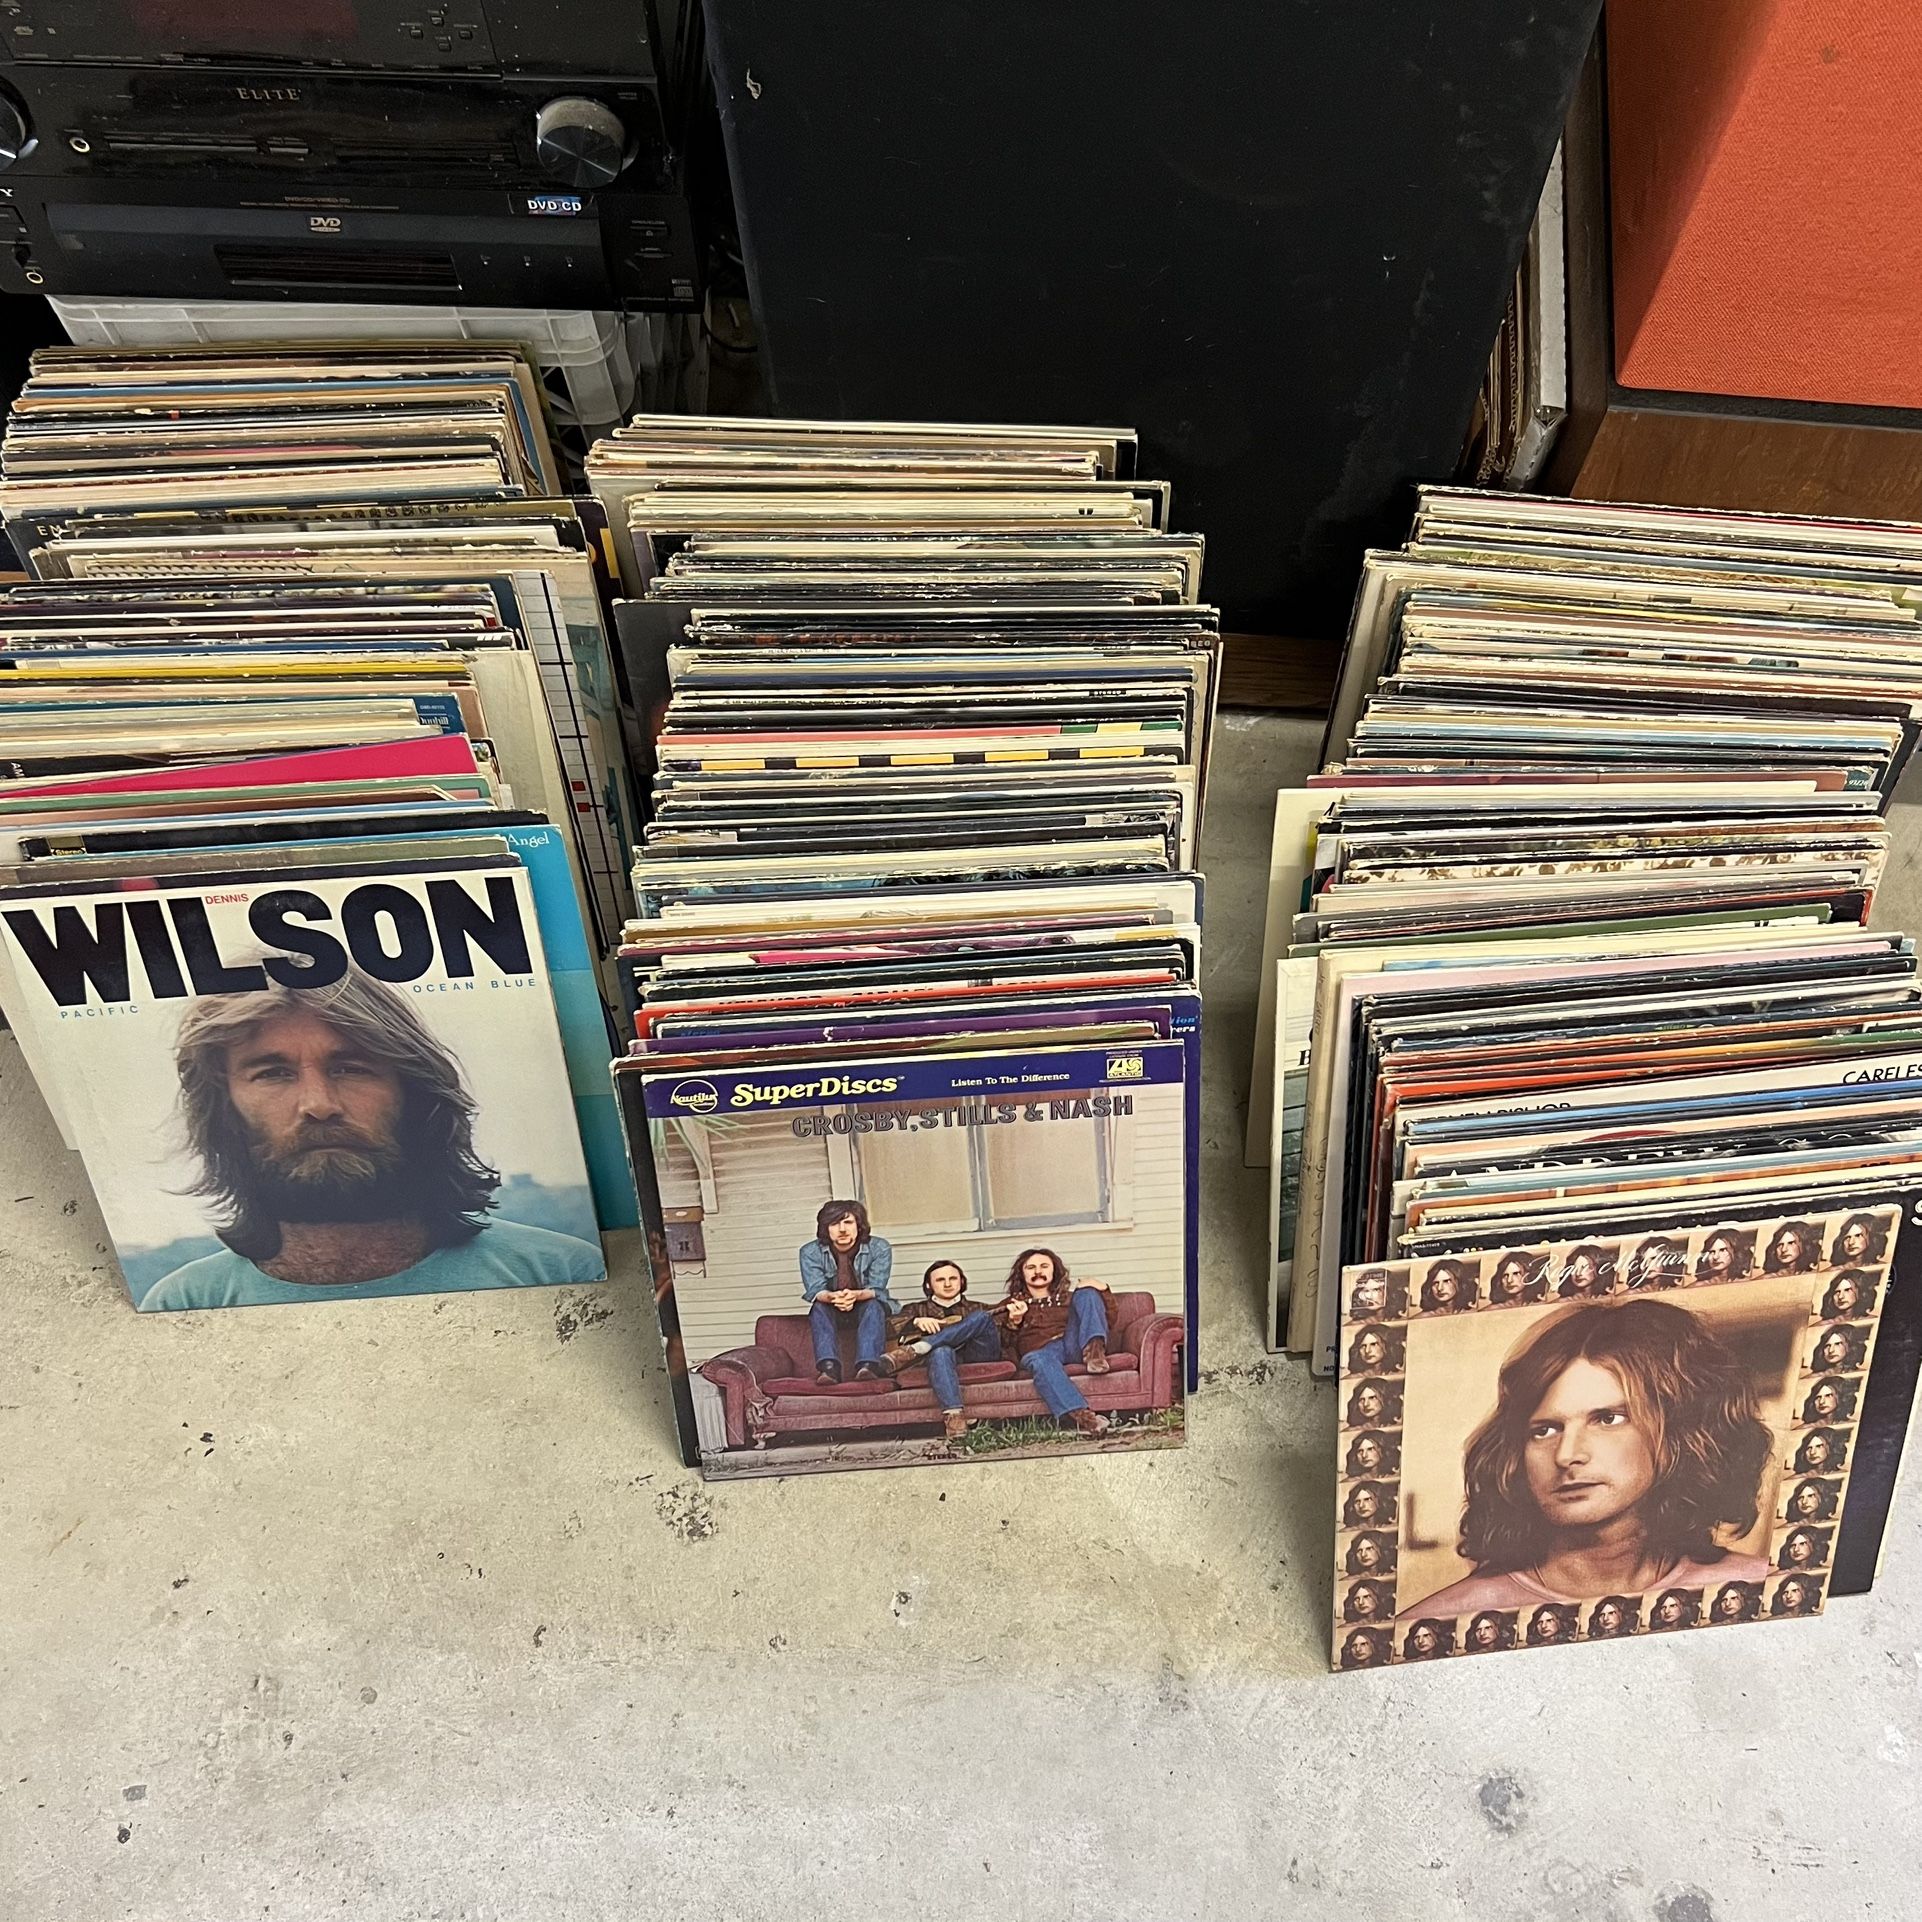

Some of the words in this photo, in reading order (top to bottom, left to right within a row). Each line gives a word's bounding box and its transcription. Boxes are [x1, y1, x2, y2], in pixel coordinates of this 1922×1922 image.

[236, 87, 299, 100] ELITE
[527, 200, 557, 210] DVD
[562, 201, 582, 211] CD
[311, 217, 341, 227] DVD
[508, 831, 550, 848] Angel
[205, 893, 249, 905] DENNIS
[1, 876, 534, 1007] WILSON
[413, 982, 474, 993] OCEAN
[491, 978, 536, 989] BLUE
[61, 1005, 139, 1019] PACIFIC
[951, 1077, 983, 1088] Listen
[985, 1076, 998, 1086] To
[999, 1075, 1019, 1085] The
[1021, 1072, 1070, 1083] Difference
[730, 1076, 898, 1107] SuperDiscs
[1023, 1103, 1044, 1122] &
[1049, 1095, 1134, 1121] NASH
